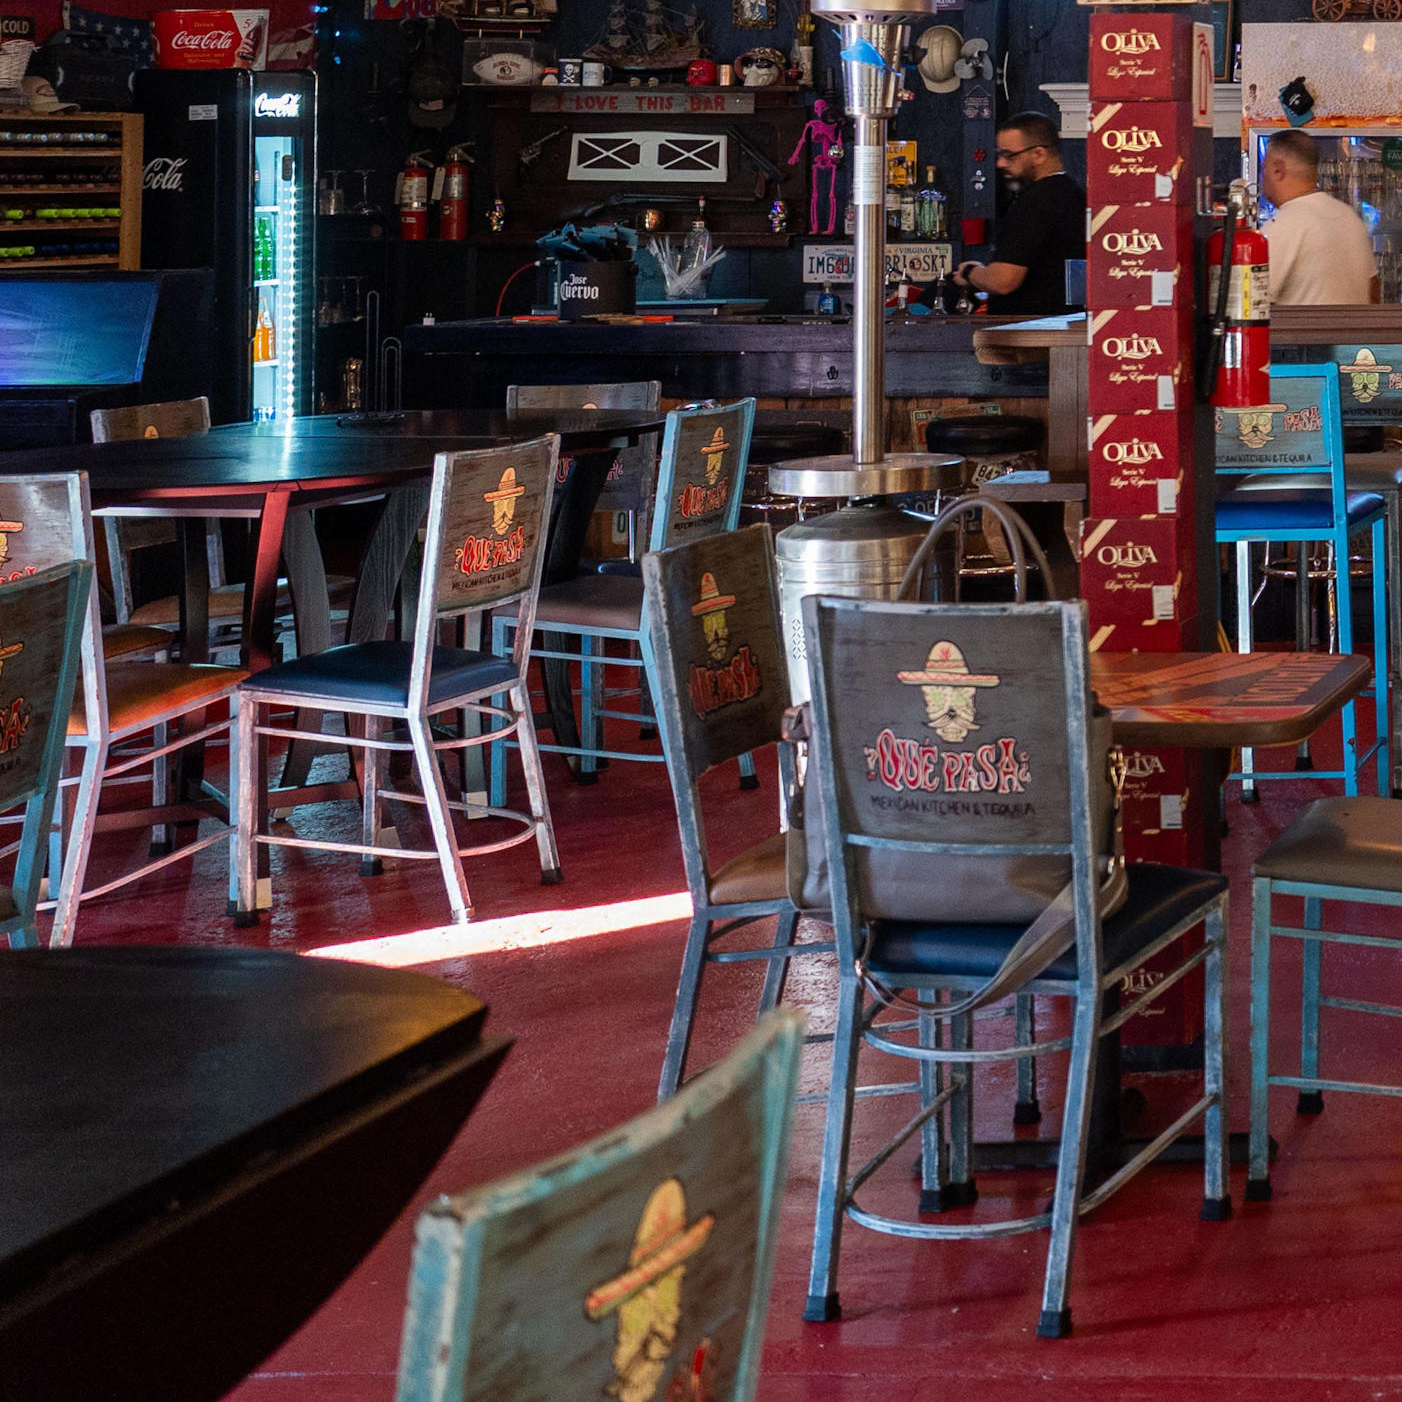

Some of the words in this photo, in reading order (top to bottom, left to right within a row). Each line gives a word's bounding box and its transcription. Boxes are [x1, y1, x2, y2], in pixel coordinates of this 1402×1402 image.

[3, 19, 29, 34] COLD
[1101, 28, 1162, 55] OLIVA
[575, 95, 619, 111] LOVE
[635, 95, 674, 111] THIS
[689, 94, 727, 111] BAR
[1101, 126, 1162, 152] OLIVA
[1102, 228, 1164, 255] OLIVA
[560, 280, 600, 302] Cuervo
[569, 273, 588, 286] Jose
[1102, 333, 1164, 360] OLIVA
[1102, 438, 1164, 465] OLIVA
[1098, 542, 1158, 568] OLIVA
[1125, 751, 1166, 778] LIVA
